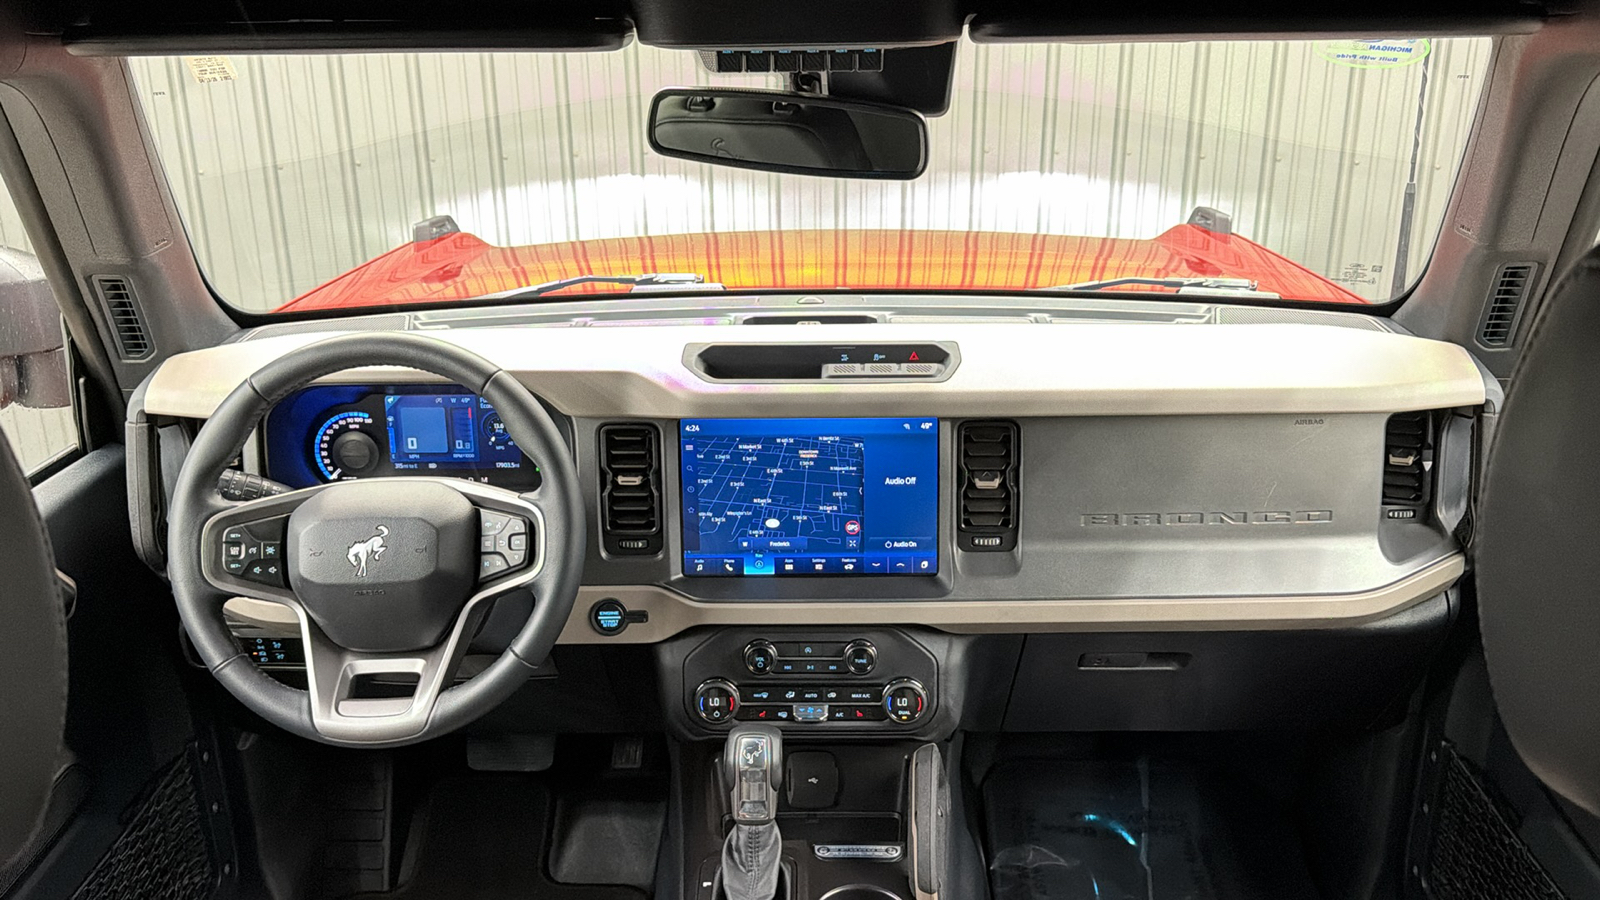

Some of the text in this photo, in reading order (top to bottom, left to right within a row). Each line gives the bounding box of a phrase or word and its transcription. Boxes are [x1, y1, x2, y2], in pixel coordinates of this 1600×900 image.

[408, 438, 417, 449] 0
[1080, 510, 1332, 526] BRONCO
[709, 698, 719, 706] LO
[897, 698, 907, 706] LO
